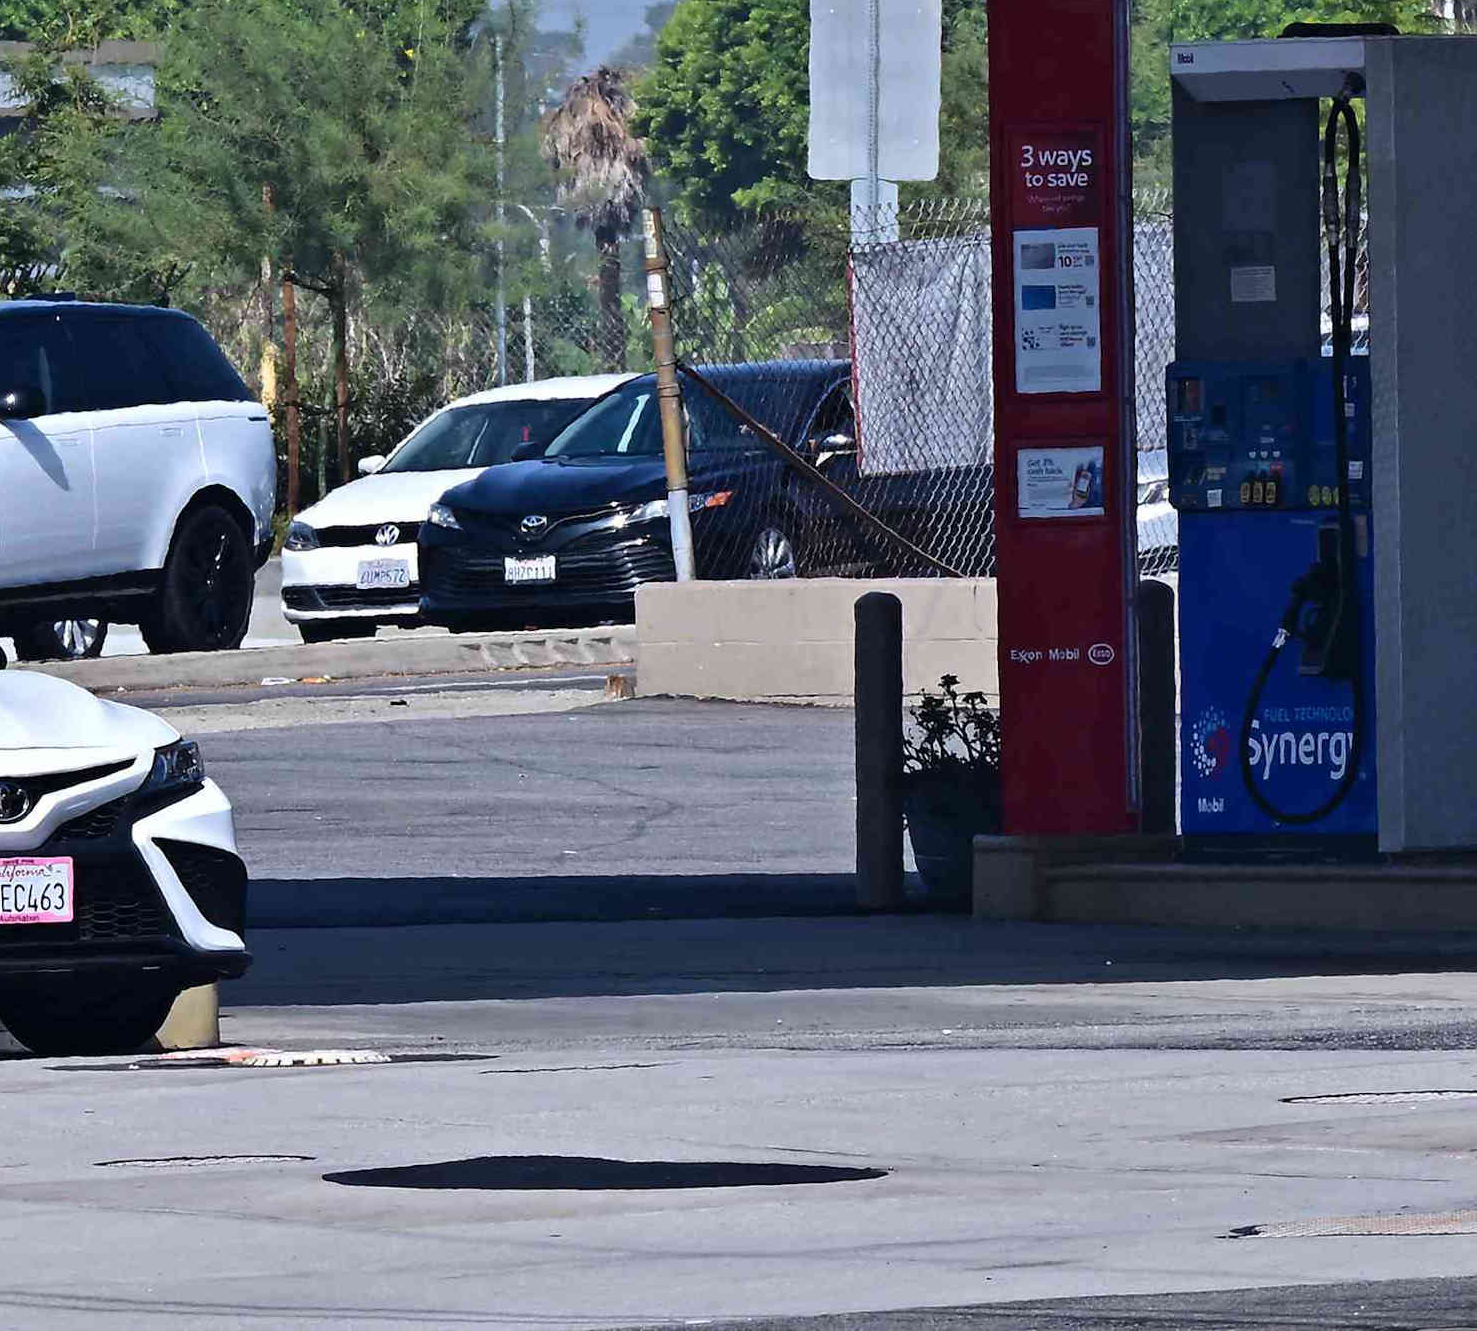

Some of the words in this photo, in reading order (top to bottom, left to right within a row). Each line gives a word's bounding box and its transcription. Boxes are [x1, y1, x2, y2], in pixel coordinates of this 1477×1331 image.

[1020, 145, 1035, 167] 3
[1038, 149, 1093, 172] ways
[1025, 171, 1044, 187] to
[1047, 172, 1089, 187] save
[1058, 255, 1072, 268] 10
[1010, 648, 1043, 663] Exxon
[1049, 648, 1080, 661] Mobil
[1263, 708, 1291, 722] FUEL
[1293, 706, 1354, 722] TECHNOLO
[1197, 797, 1225, 813] Mobil
